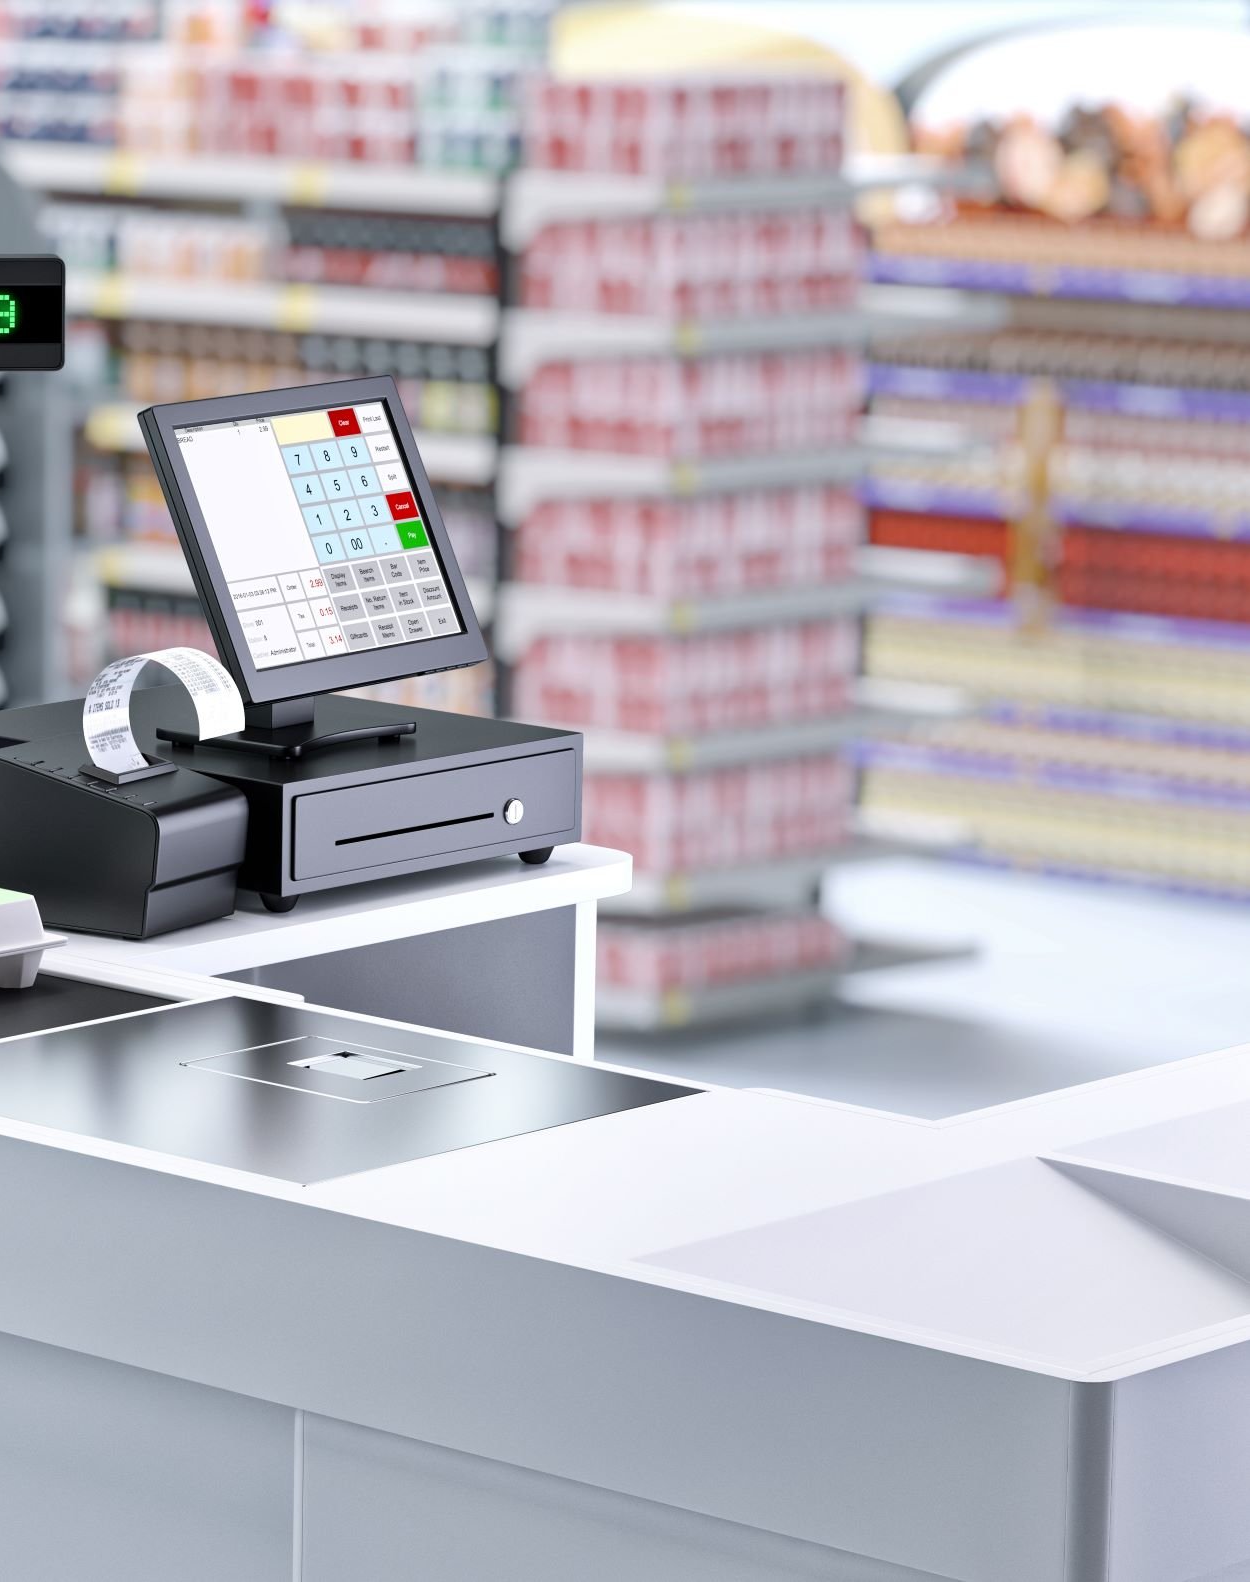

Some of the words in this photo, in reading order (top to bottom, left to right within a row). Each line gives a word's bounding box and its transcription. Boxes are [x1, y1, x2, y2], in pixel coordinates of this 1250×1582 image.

[294, 454, 300, 466] 7
[323, 450, 330, 462] 8
[350, 446, 358, 458] 9
[306, 484, 312, 495] 4
[334, 480, 340, 491] 5
[360, 476, 368, 487] 6
[316, 513, 322, 526] 1
[344, 509, 352, 521] 2
[370, 504, 378, 517] 3
[326, 542, 332, 554] 0
[350, 538, 363, 550] 00
[407, 532, 416, 540] Pay
[358, 567, 374, 576] Search
[419, 566, 430, 574] Price
[330, 572, 346, 580] Display
[422, 586, 440, 594] Discount
[404, 598, 414, 606] Stock
[320, 606, 334, 616] 0.15
[340, 604, 358, 612] Receipts
[408, 618, 420, 626] Open
[408, 626, 423, 634] Drawer
[328, 634, 342, 644] 3.14
